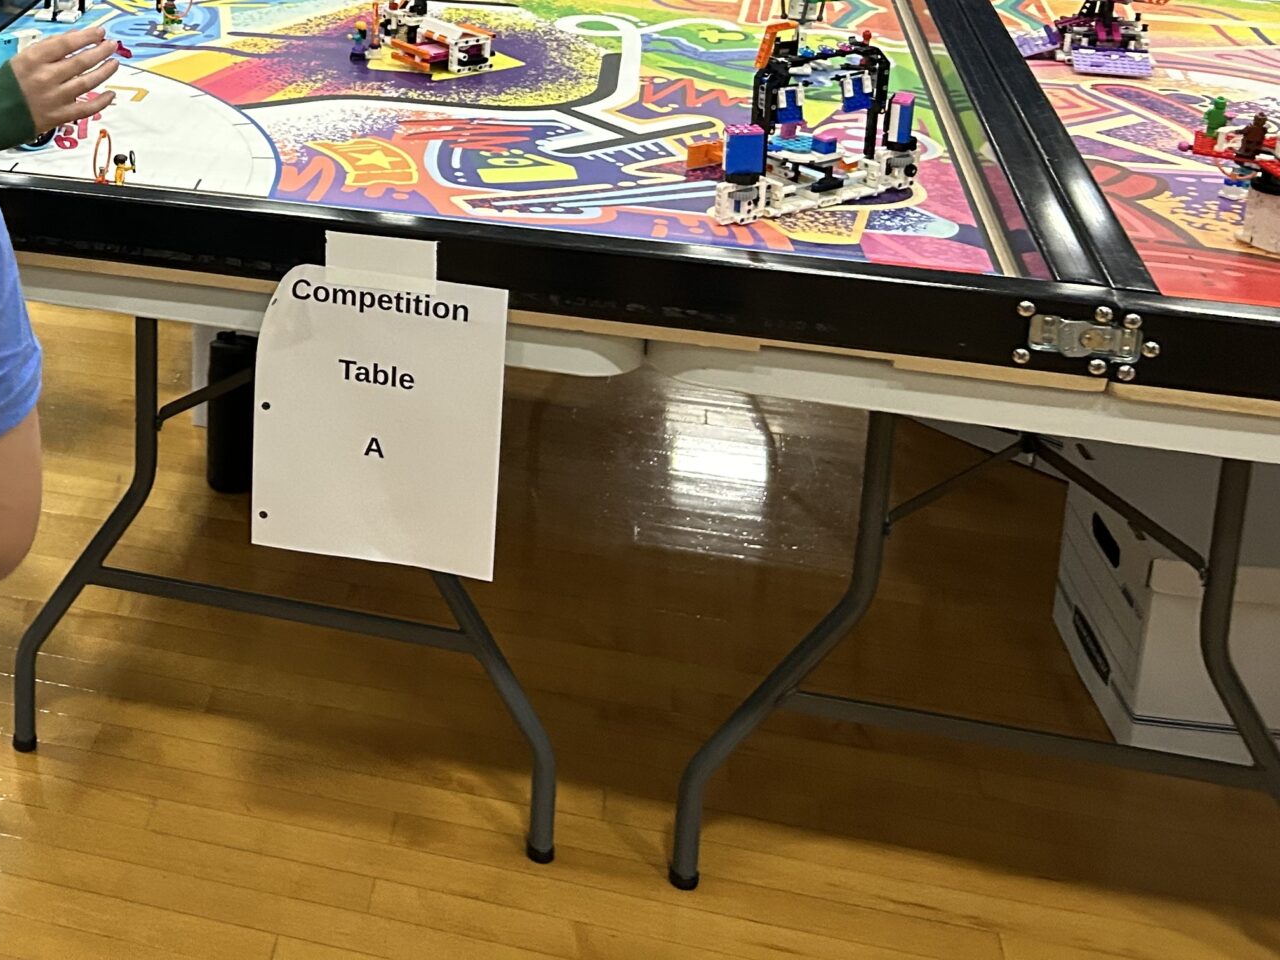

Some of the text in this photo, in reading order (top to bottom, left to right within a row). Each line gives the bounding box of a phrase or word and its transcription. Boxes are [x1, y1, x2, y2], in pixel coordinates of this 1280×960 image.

[291, 279, 470, 322] Competition
[338, 359, 415, 390] Table
[363, 437, 385, 458] A
